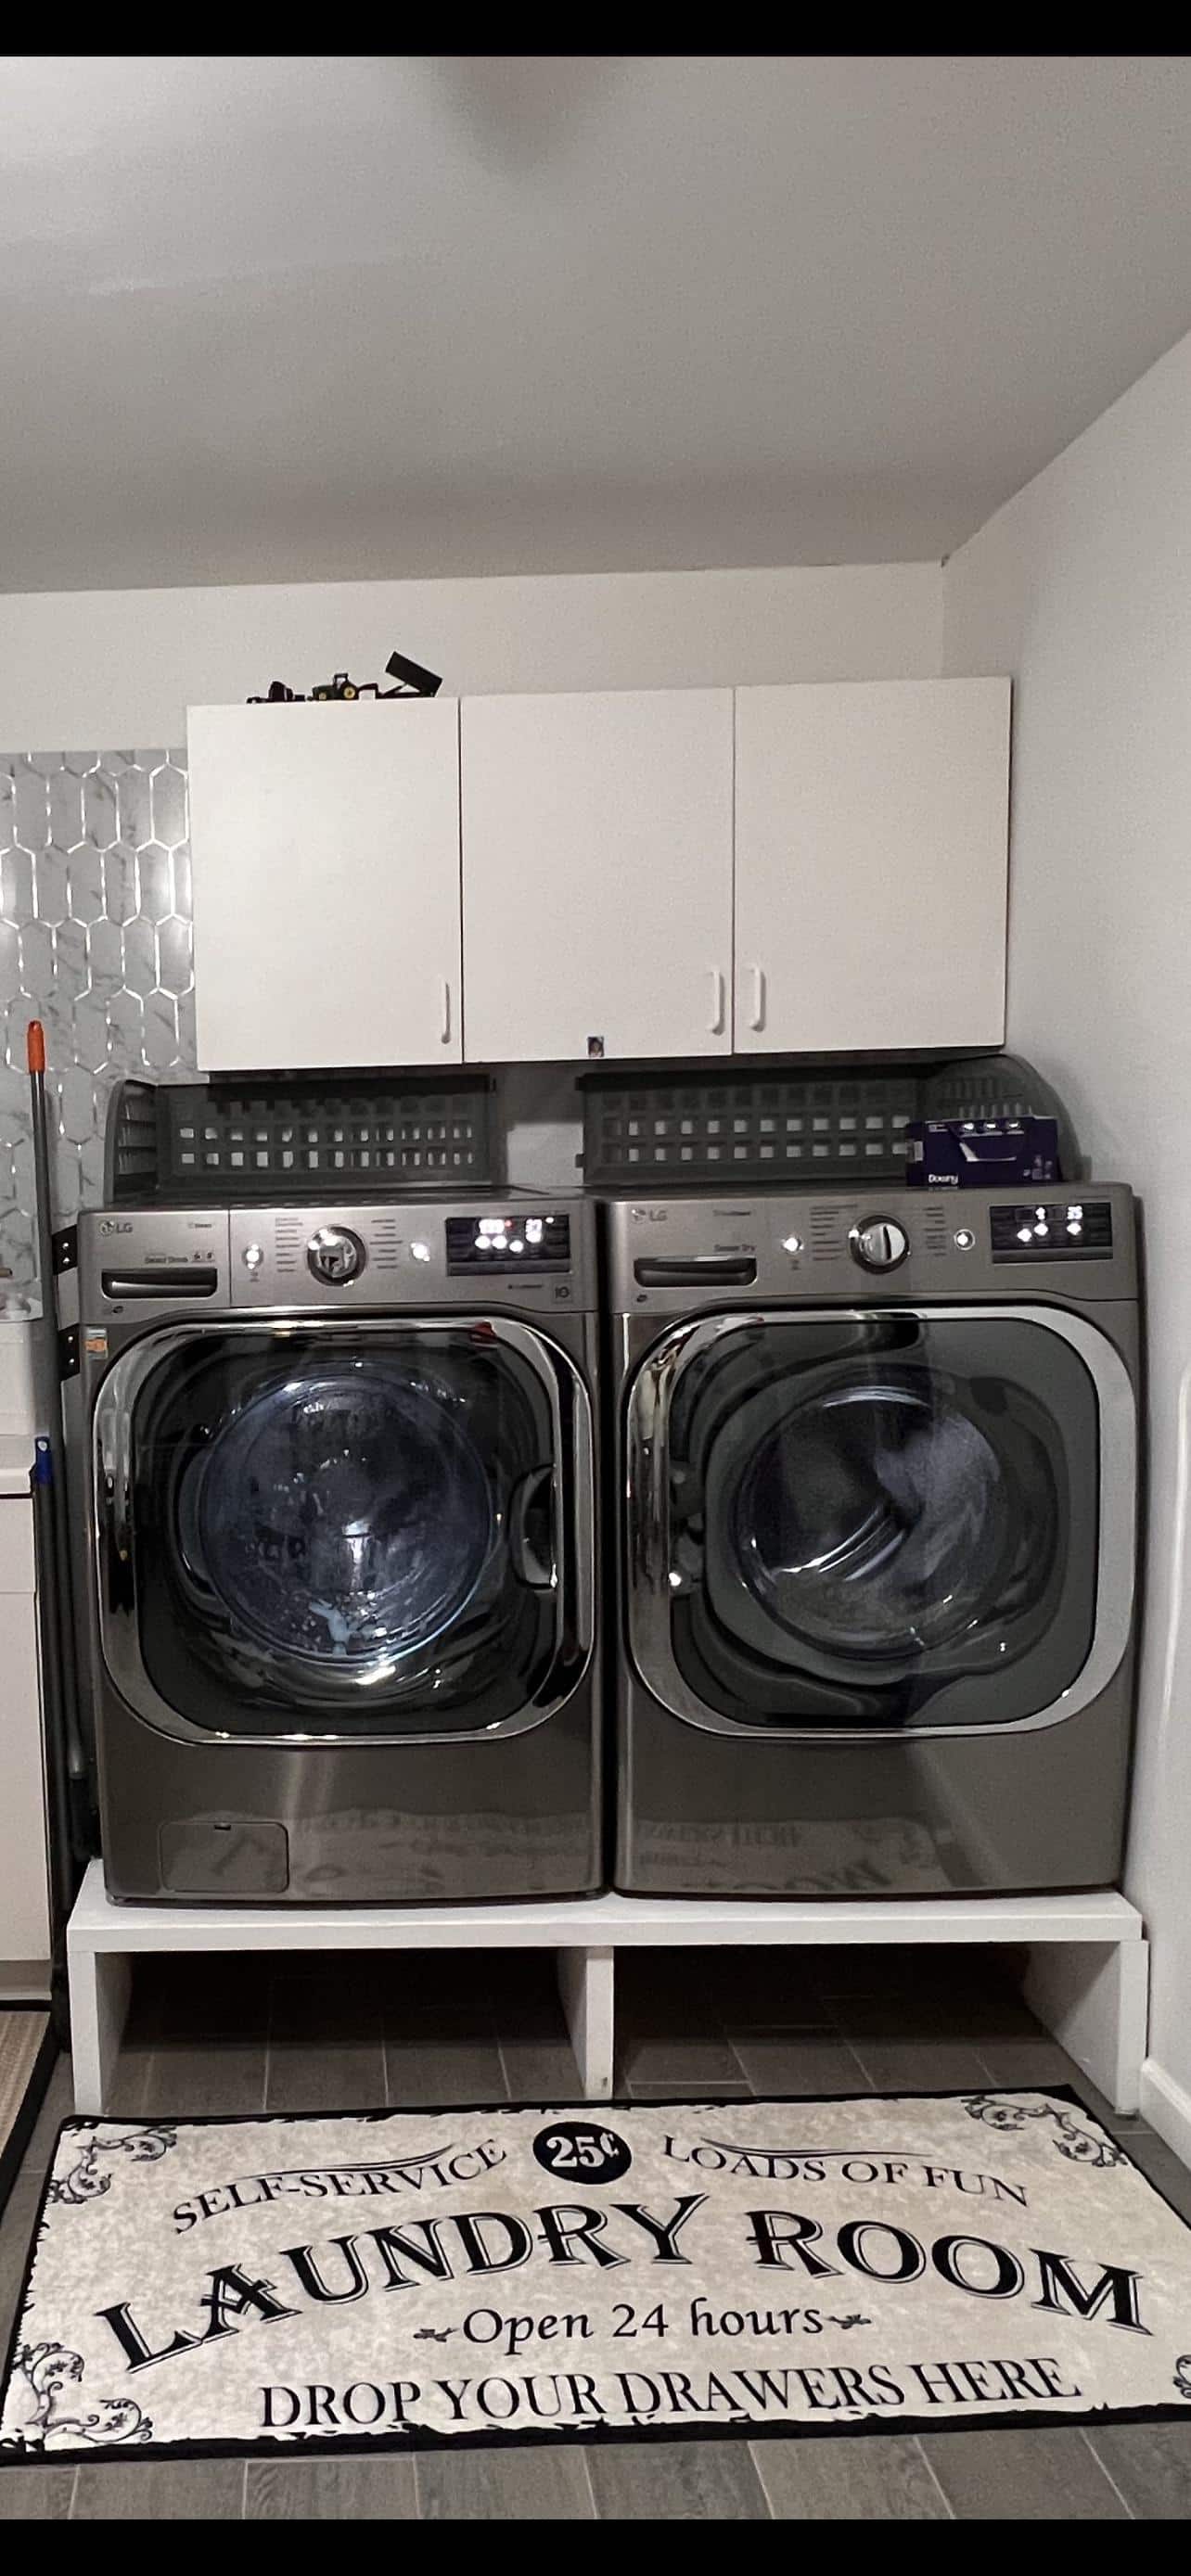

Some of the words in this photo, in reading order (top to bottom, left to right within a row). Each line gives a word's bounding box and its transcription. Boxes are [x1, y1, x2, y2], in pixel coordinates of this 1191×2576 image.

[116, 1223, 134, 1233] LG
[649, 1209, 668, 1221] LG
[546, 2132, 620, 2169] 25¢
[663, 2135, 826, 2182] LOADS
[840, 2161, 910, 2185] OF
[920, 2164, 1030, 2208] FUN
[173, 2139, 506, 2235] SELF-SERVICE
[96, 2192, 710, 2374] LAUNDRY
[744, 2210, 1154, 2337] ROOM
[463, 2308, 593, 2355] Open
[612, 2303, 669, 2338] 24
[691, 2297, 824, 2336] hours
[261, 2380, 422, 2427] DROP
[432, 2372, 608, 2419] YOUR
[614, 2364, 905, 2414] DRAWERS
[907, 2357, 1082, 2404] HERE
